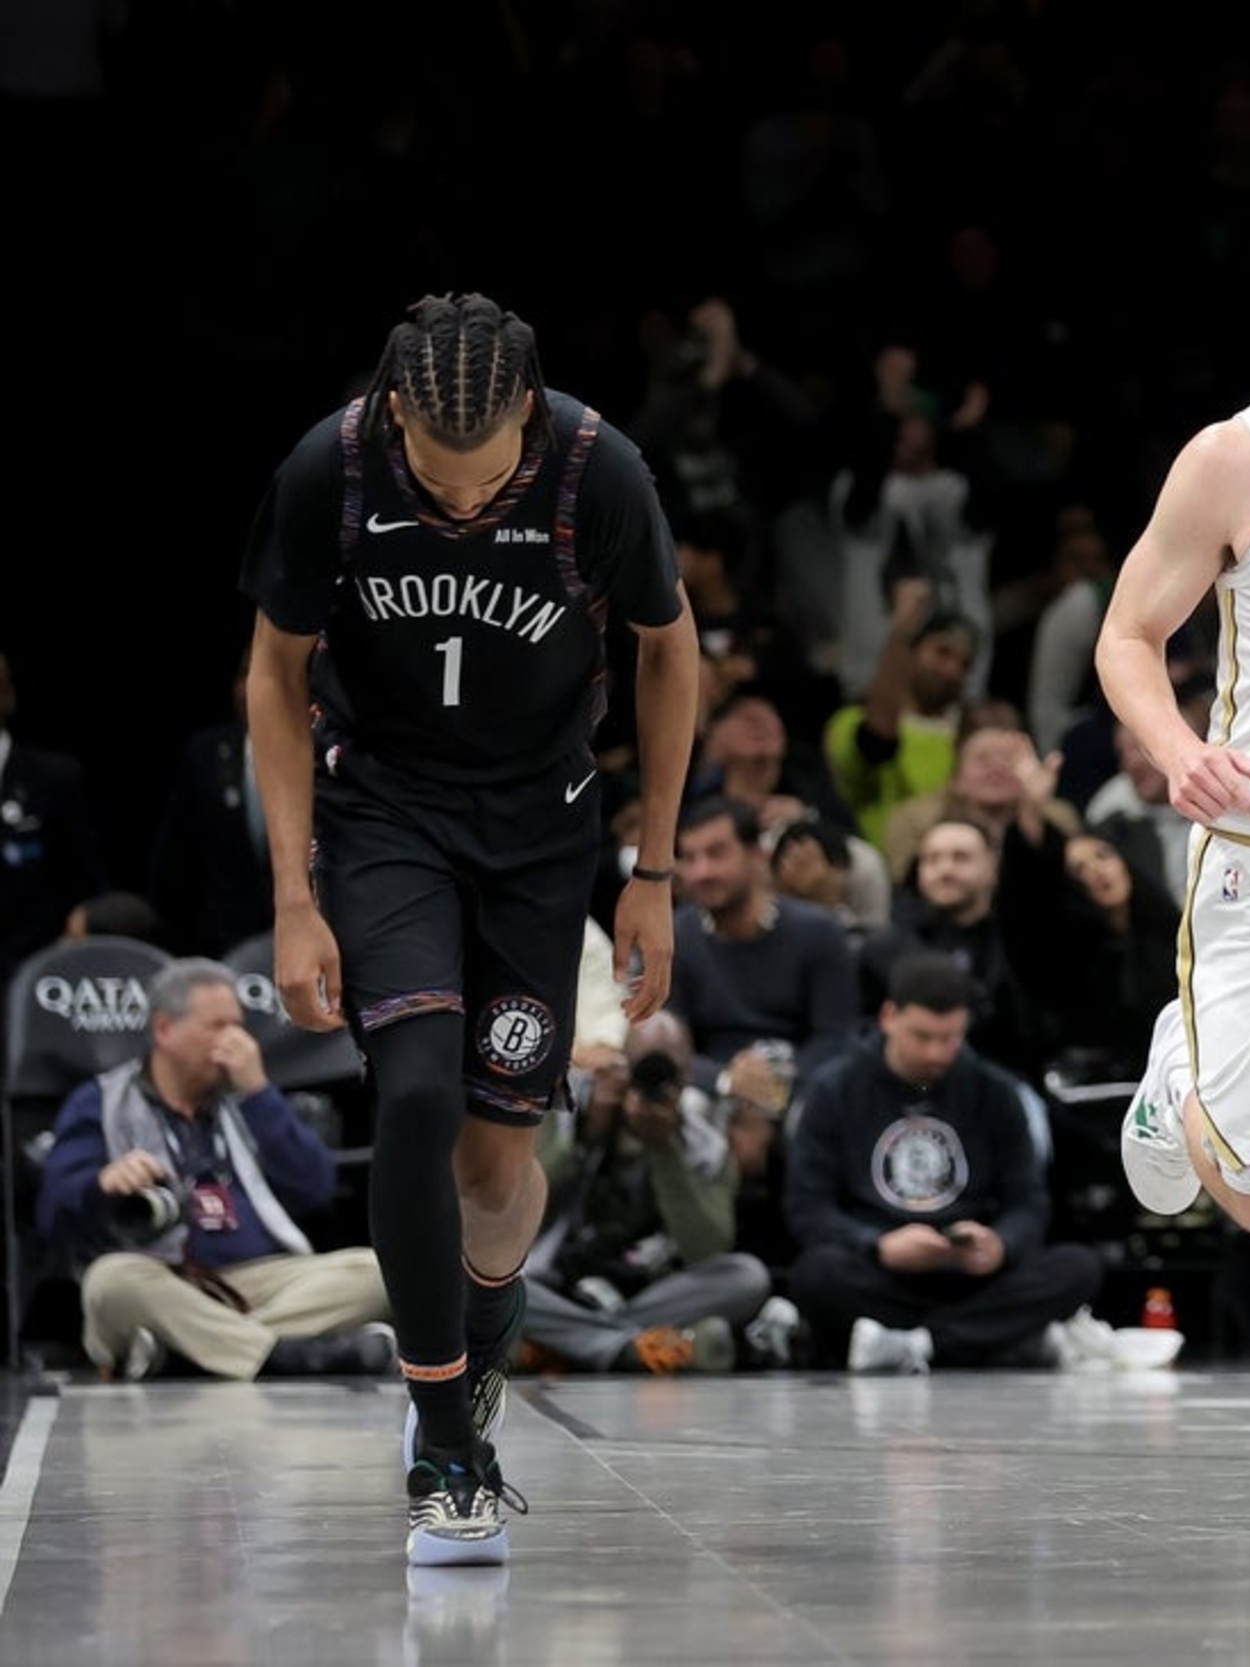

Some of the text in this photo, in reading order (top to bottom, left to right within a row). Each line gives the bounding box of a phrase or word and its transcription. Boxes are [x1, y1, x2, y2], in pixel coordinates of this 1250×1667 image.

[354, 574, 566, 644] ROOKLYN
[435, 636, 463, 706] 1
[35, 976, 151, 1018] QATA
